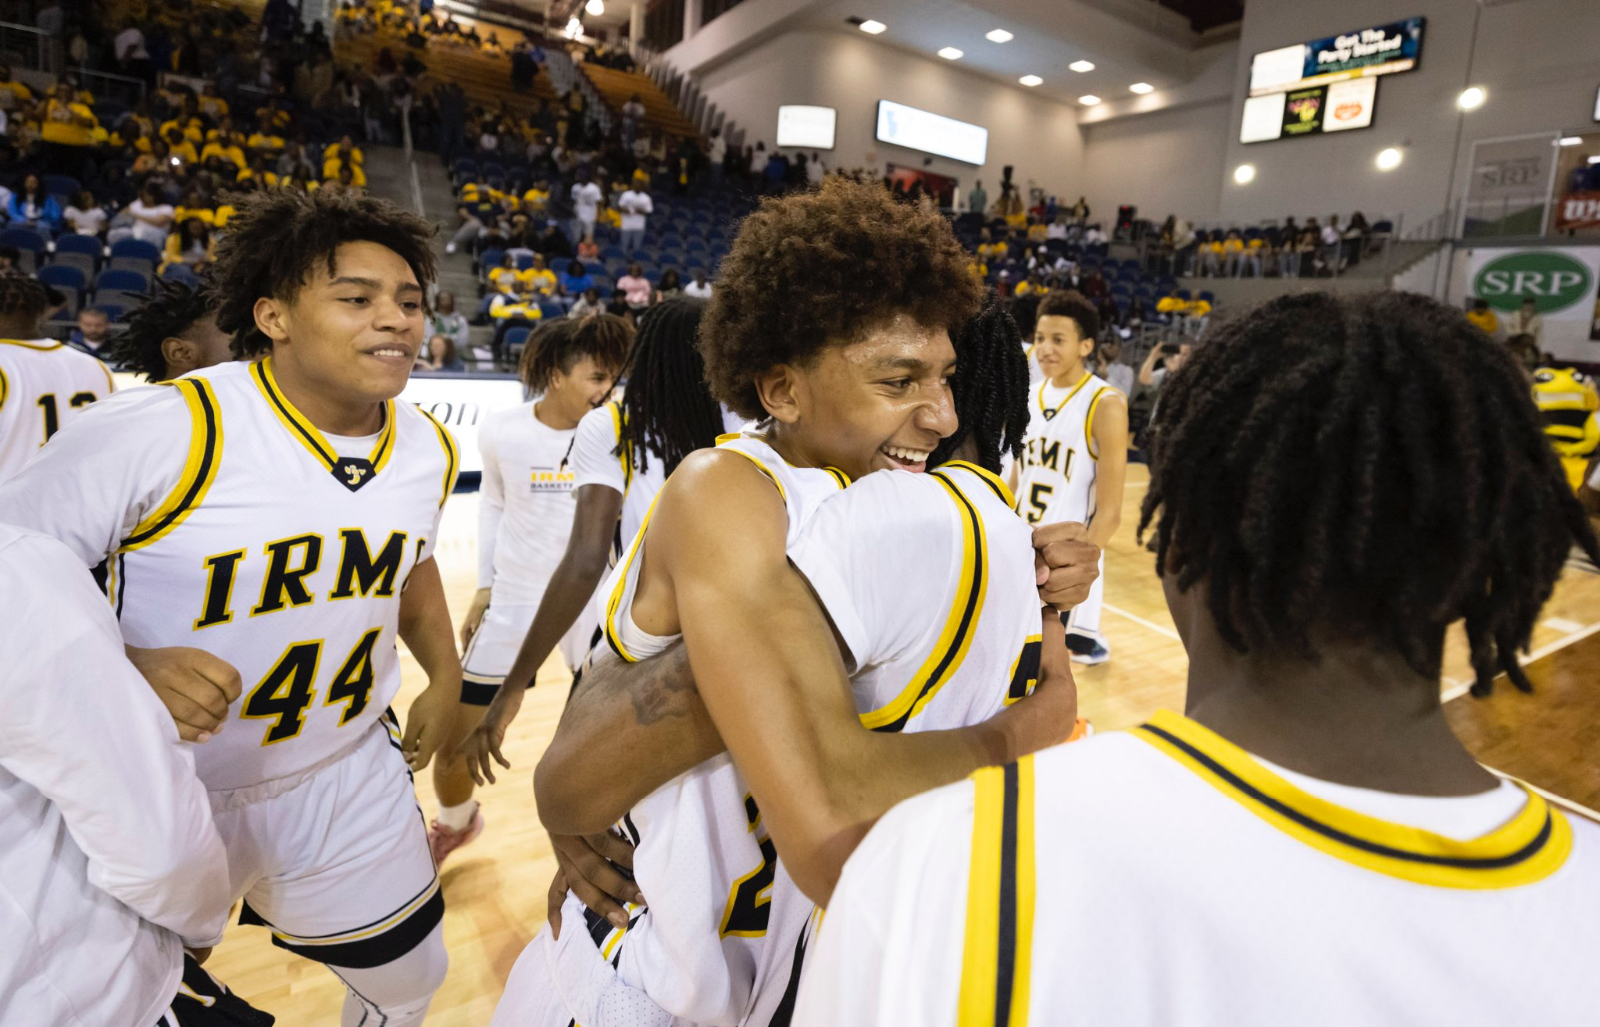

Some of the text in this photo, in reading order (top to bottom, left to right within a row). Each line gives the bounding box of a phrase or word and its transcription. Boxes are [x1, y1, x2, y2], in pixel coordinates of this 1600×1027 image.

[1318, 49, 1352, 65] Party
[1352, 34, 1402, 58] Started
[1334, 28, 1386, 50] Get The
[1481, 270, 1583, 296] SRP
[240, 627, 383, 747] 44
